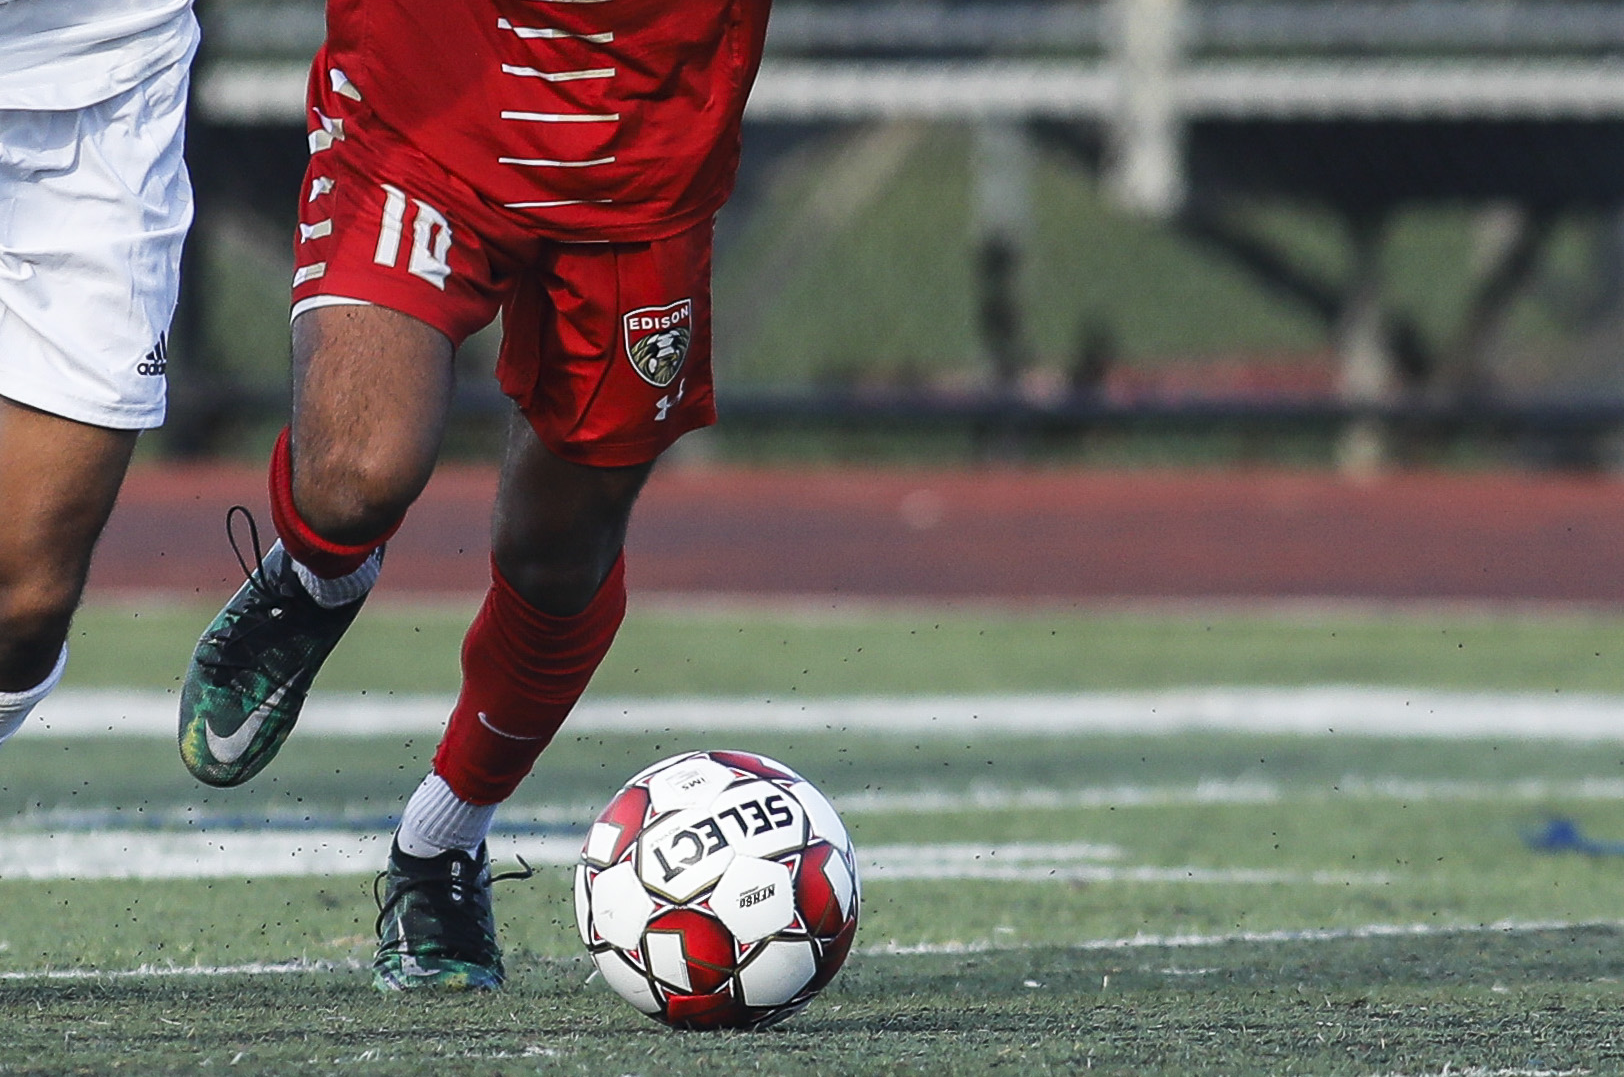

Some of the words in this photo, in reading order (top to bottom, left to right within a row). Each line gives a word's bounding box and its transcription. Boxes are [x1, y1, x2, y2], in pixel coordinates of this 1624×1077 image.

[374, 183, 453, 291] 10
[629, 305, 689, 330] EDISON
[652, 795, 794, 884] SELECT
